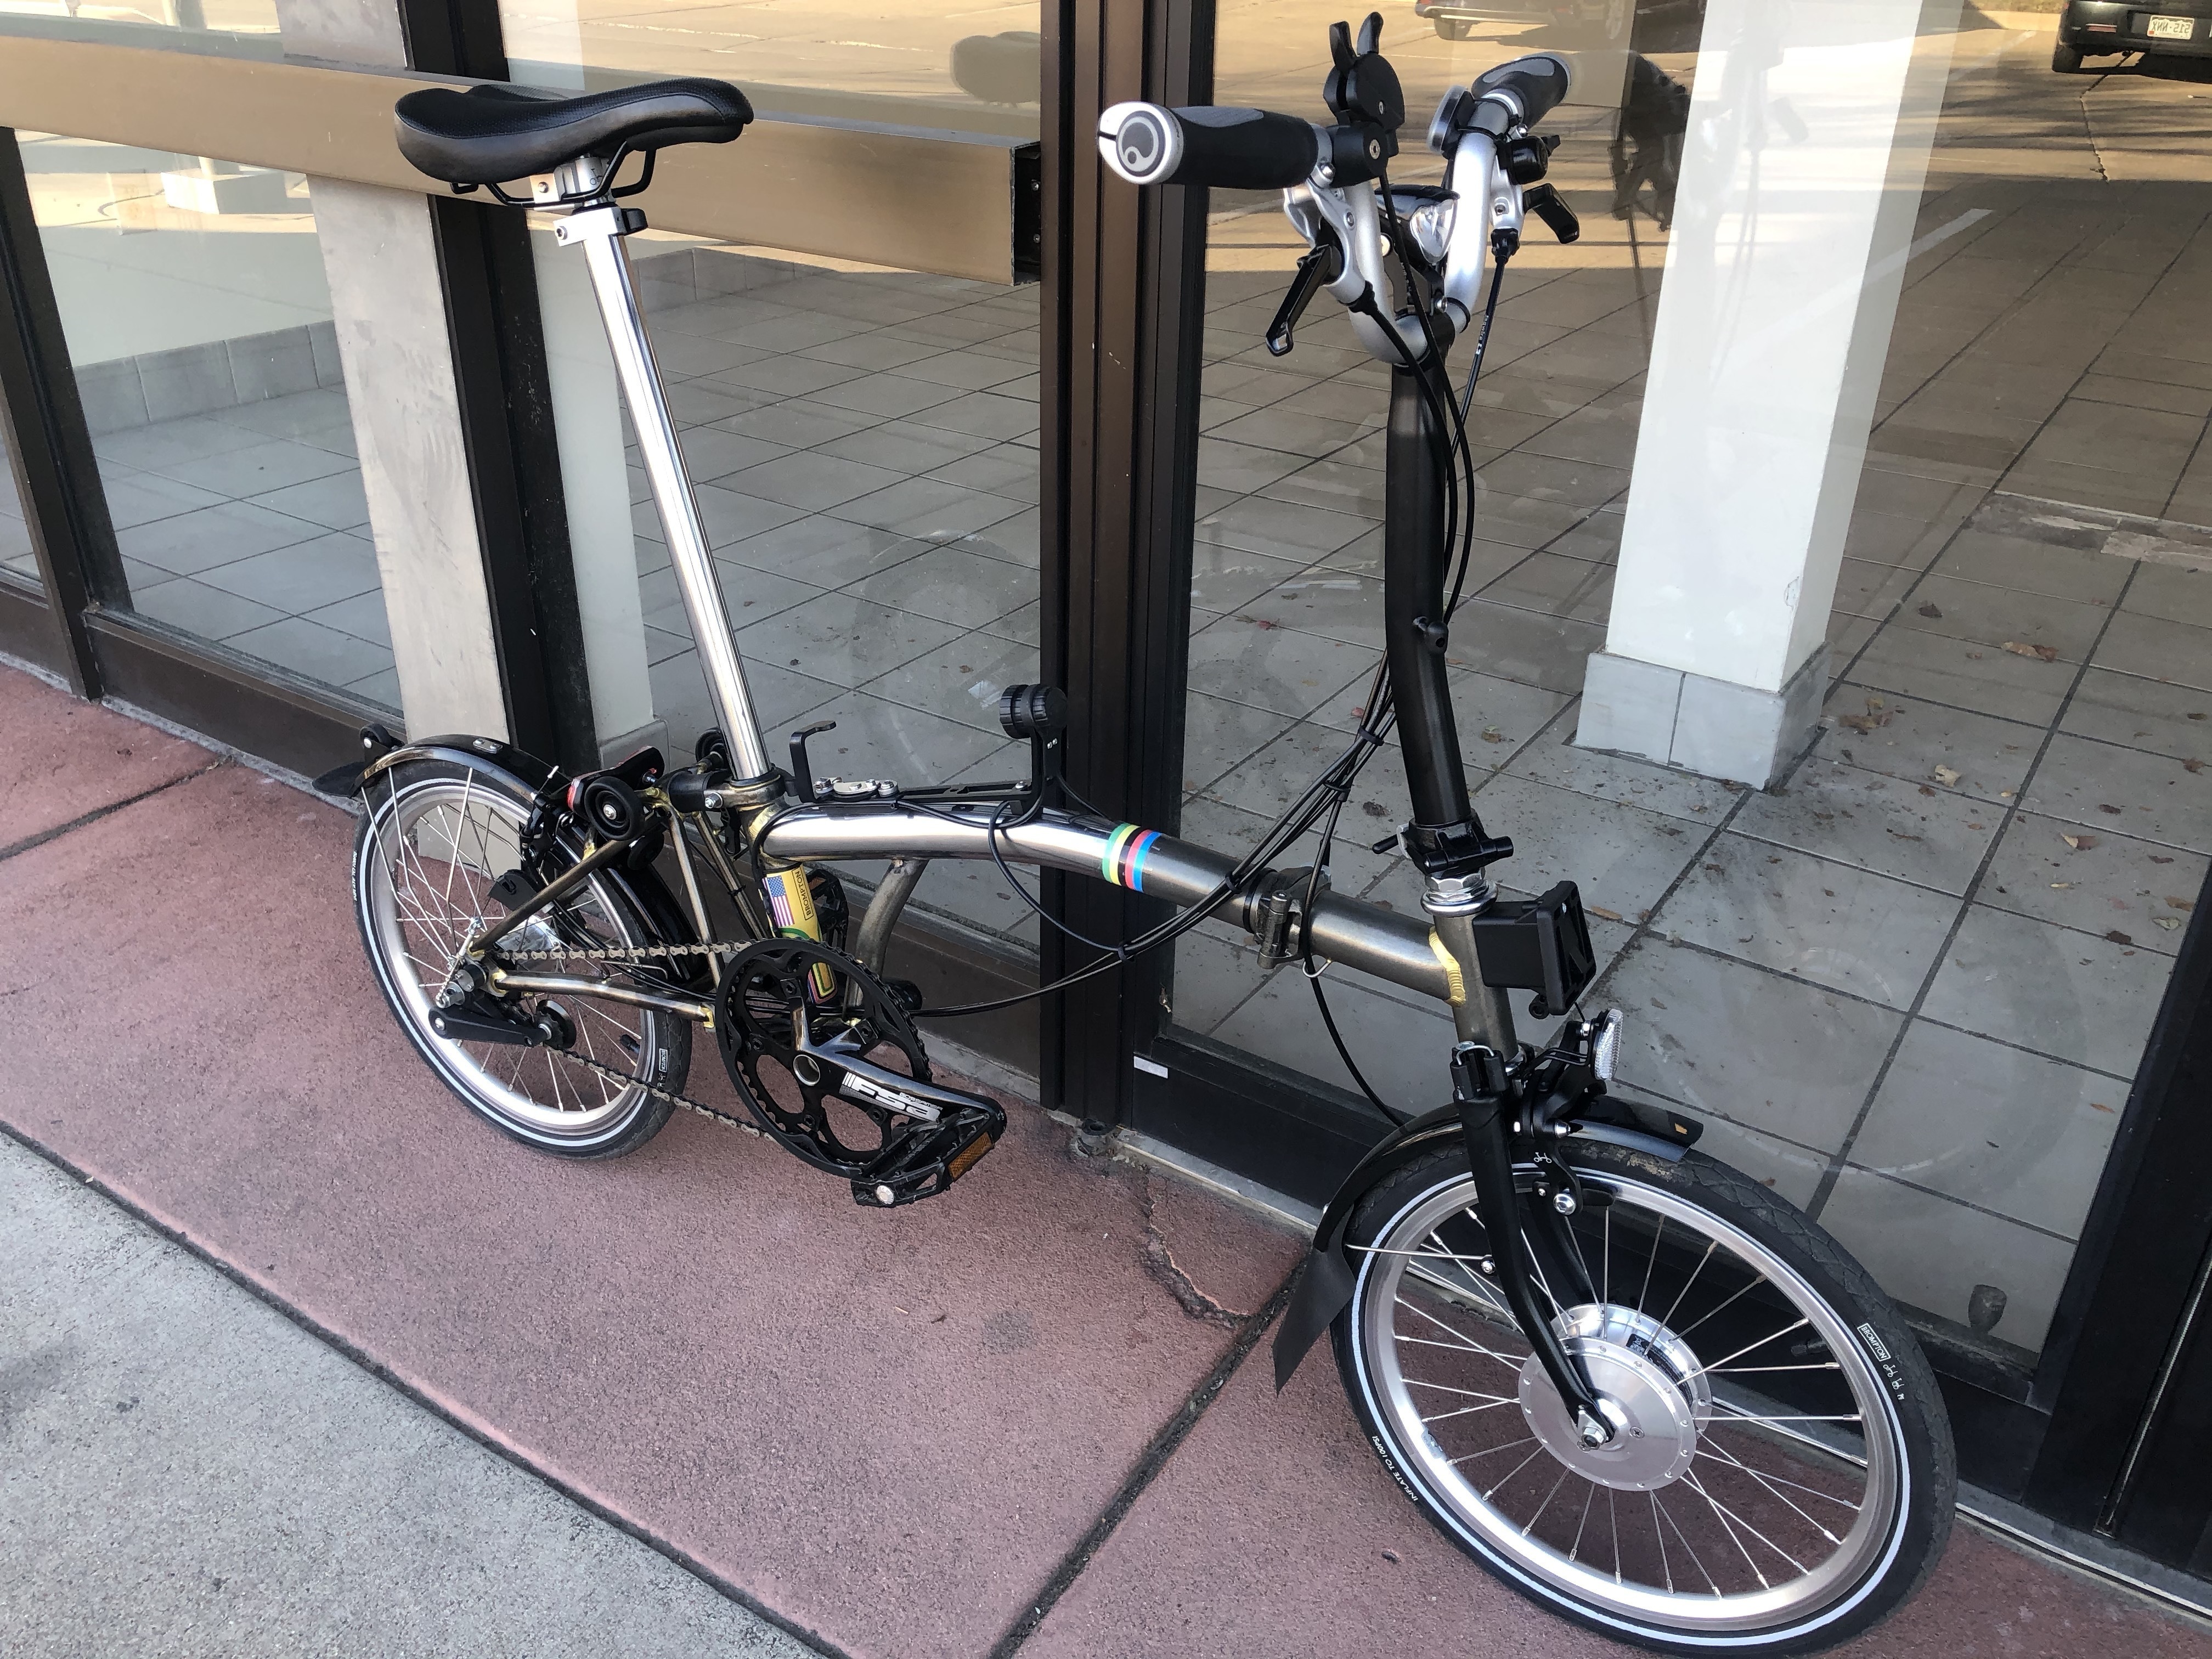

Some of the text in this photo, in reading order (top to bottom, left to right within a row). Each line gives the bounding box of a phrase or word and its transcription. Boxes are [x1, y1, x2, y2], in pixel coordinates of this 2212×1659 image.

[795, 871, 811, 916] BROMPTON
[1861, 1326, 1887, 1359] BROMPTON
[1372, 1436, 1418, 1501] INFLATE TO 100PSI
